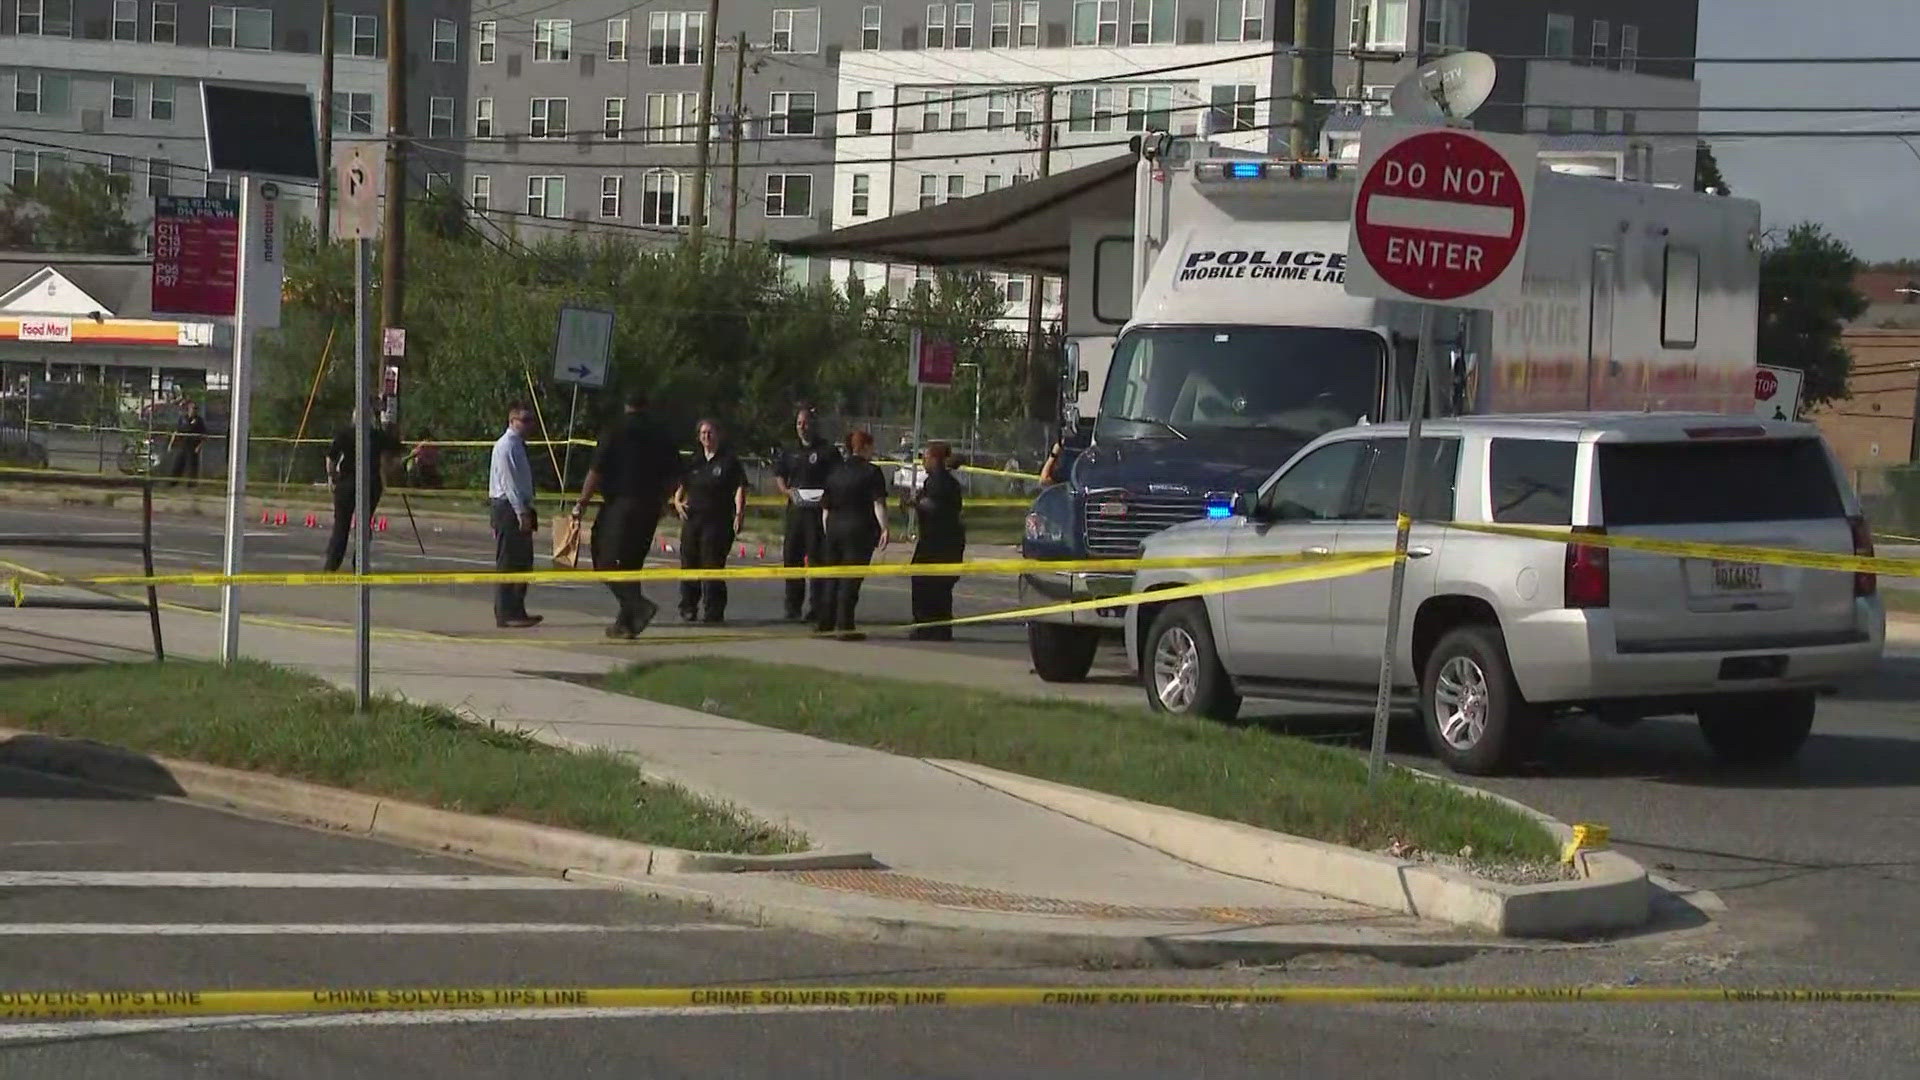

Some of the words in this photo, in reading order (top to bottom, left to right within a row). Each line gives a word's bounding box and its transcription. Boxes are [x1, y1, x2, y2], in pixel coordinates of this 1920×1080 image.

[1384, 160, 1426, 188] DO
[1442, 165, 1505, 197] NOT
[158, 223, 179, 235] C11
[157, 248, 180, 258] C17
[1185, 251, 1347, 270] POLICE
[1387, 236, 1483, 272] ENTER
[1180, 266, 1246, 282] MOBILE
[1251, 265, 1309, 280] CRIME
[22, 323, 45, 336] Food
[47, 324, 69, 337] Mart
[1757, 379, 1777, 392] TOP
[0, 991, 89, 1005] OLVERS
[100, 990, 145, 1005] TIPS
[151, 990, 200, 1005] LINE
[313, 990, 381, 1004] CRIME
[388, 990, 485, 1004] SOLVERS
[494, 989, 537, 1004] TIPS
[543, 990, 589, 1004] LINE
[692, 990, 753, 1004] CRIME
[760, 990, 851, 1005] SOLVERS
[857, 991, 899, 1006] TIPS
[904, 992, 947, 1006] LINE
